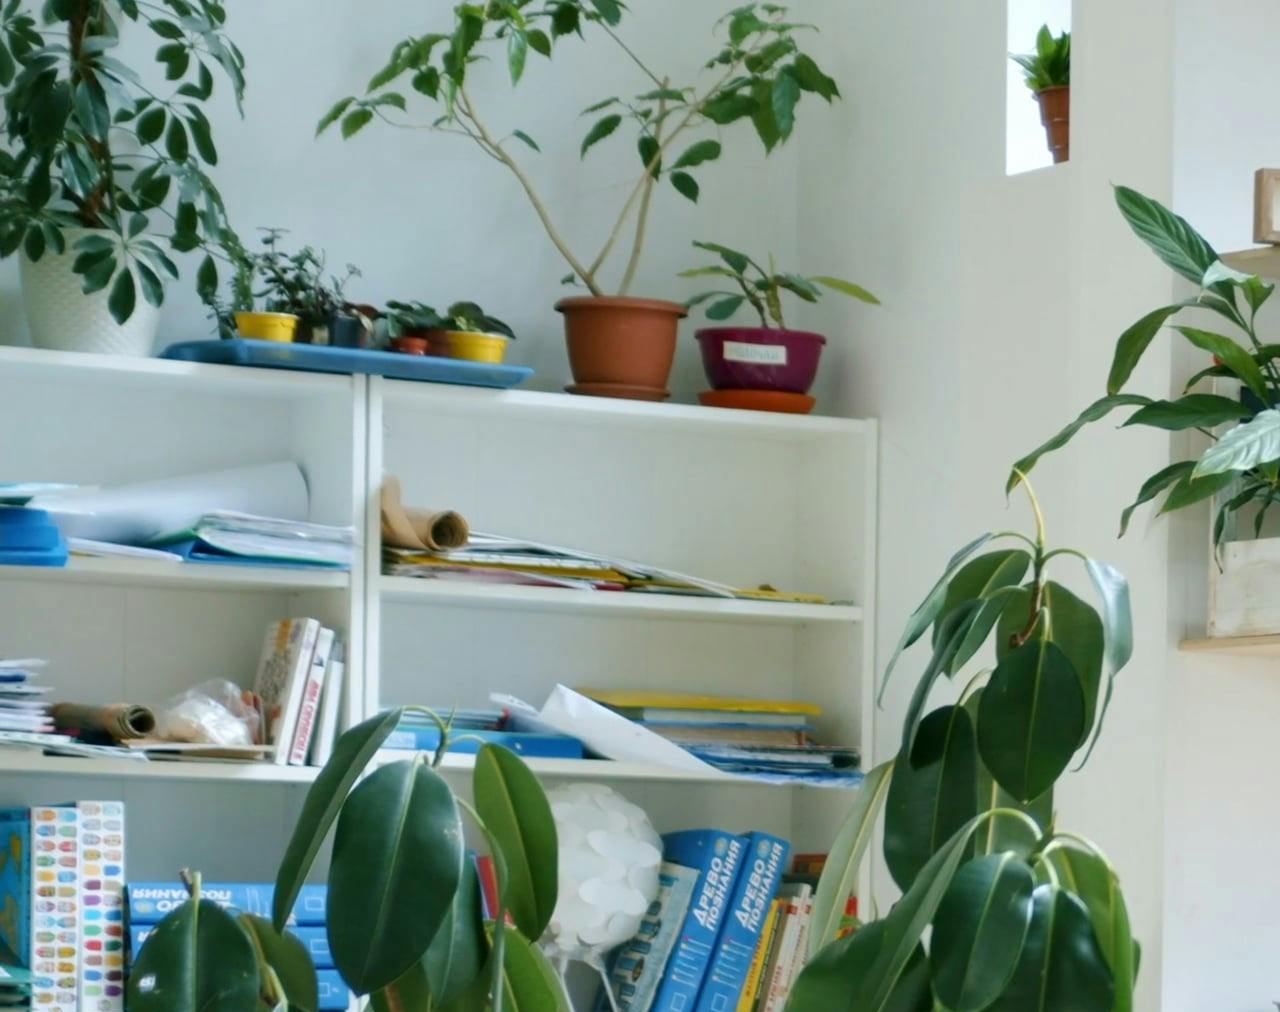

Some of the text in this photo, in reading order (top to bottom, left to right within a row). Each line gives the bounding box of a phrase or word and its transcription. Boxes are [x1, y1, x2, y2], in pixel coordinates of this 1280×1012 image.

[132, 888, 231, 901] ПОЗАНИЯ
[692, 856, 724, 927] ДРЕВО
[704, 839, 742, 932] ПОЗНАНИЯ
[735, 858, 766, 928] ДРЕВО
[746, 842, 784, 933] ПОЗНАНИЯ
